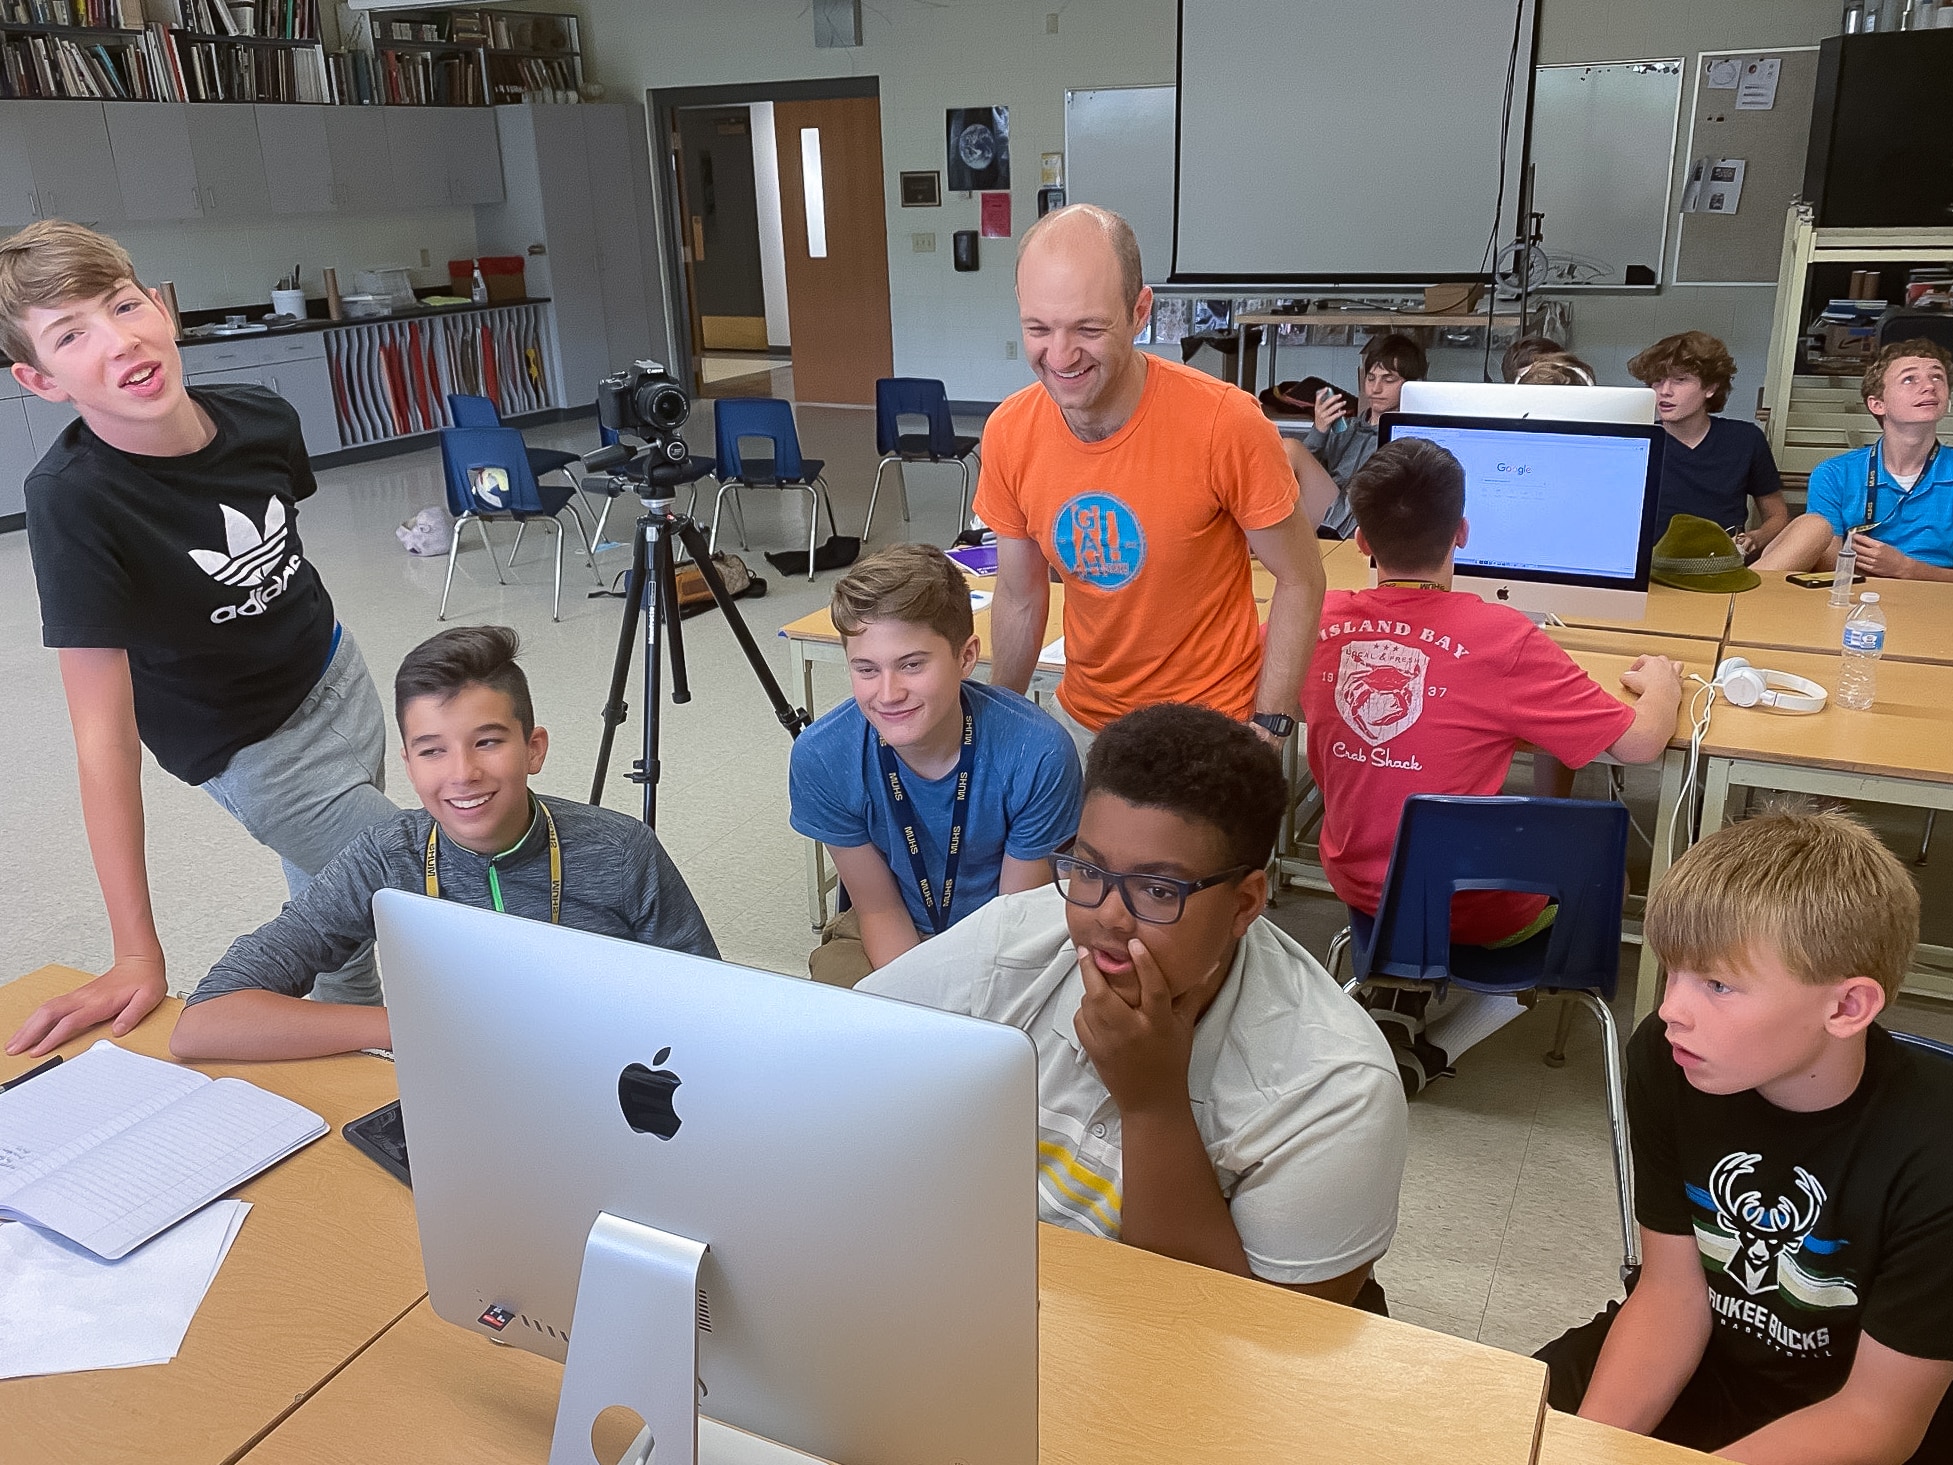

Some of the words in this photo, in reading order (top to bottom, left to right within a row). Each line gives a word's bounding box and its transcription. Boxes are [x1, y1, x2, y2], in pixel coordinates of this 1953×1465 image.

[1496, 462, 1532, 476] Google
[1318, 619, 1411, 642] ISLAND
[1419, 628, 1469, 659] BAY
[1389, 653, 1420, 664] FRESH
[1322, 671, 1334, 683] 19
[1428, 686, 1447, 698] 37
[964, 715, 973, 745] MUHS
[1332, 741, 1367, 763] Crab
[1370, 747, 1423, 771] Shack
[888, 772, 904, 802] MUHS
[956, 771, 968, 801] MUHS
[904, 825, 919, 855] MUHS
[950, 825, 961, 854] MUHS
[920, 878, 934, 908] MUHS
[942, 878, 953, 908] MUHS
[1768, 1313, 1830, 1351] BUCKS
